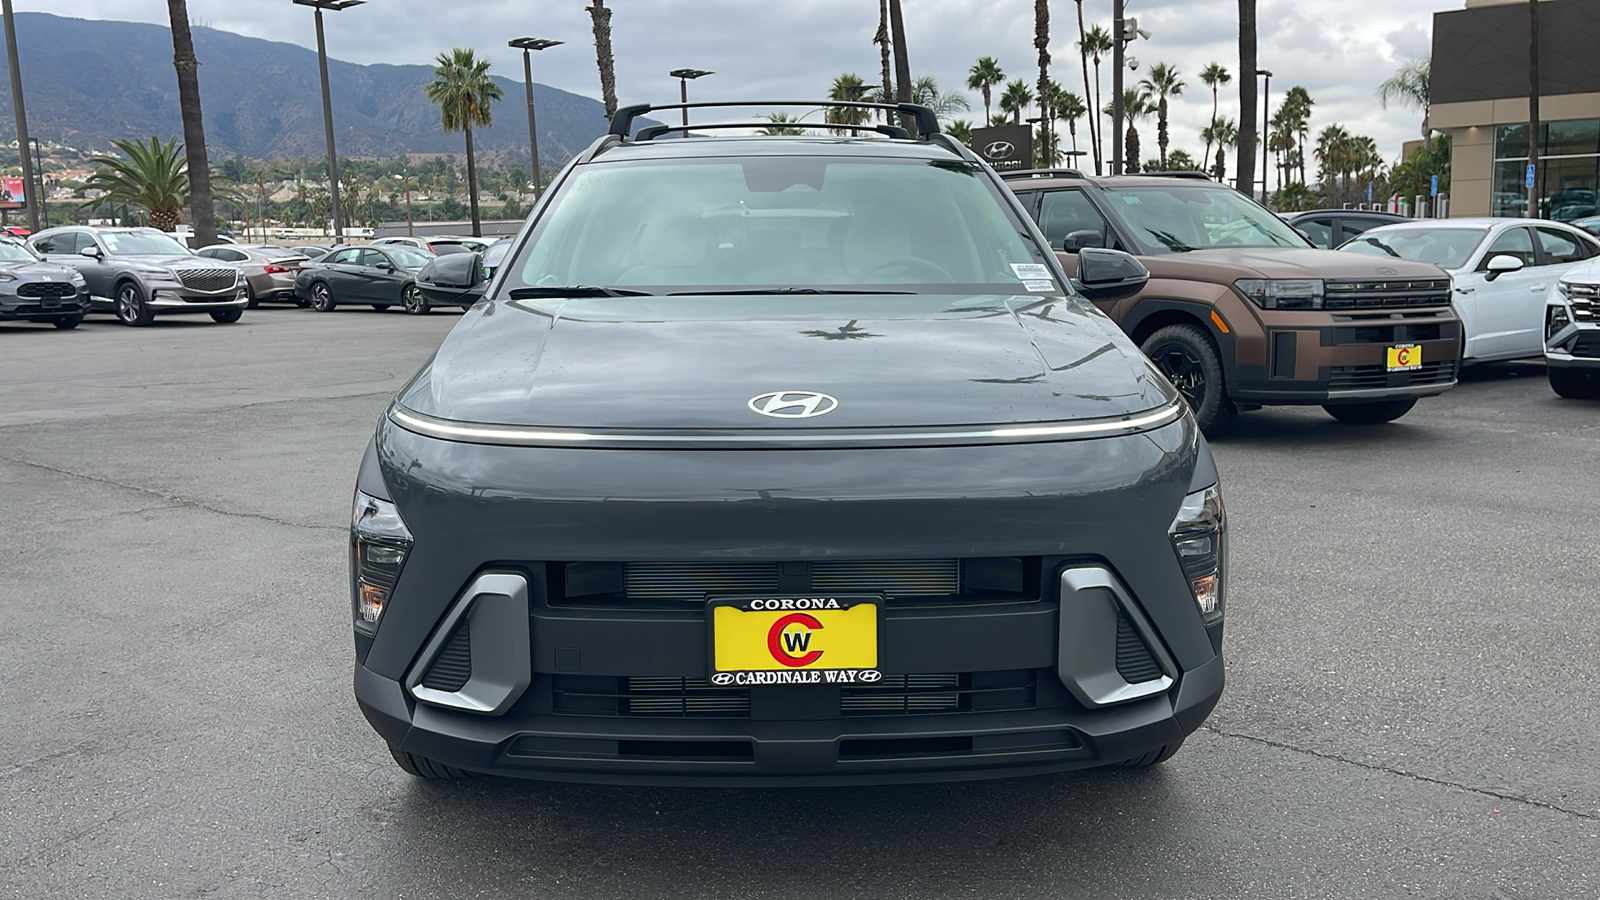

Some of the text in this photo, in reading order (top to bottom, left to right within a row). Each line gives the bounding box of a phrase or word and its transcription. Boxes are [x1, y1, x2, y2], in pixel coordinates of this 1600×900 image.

[987, 160, 1022, 170] UNDAI
[750, 598, 840, 610] CORONA
[767, 613, 825, 667] C W
[735, 670, 858, 685] CARDINALE WAY
